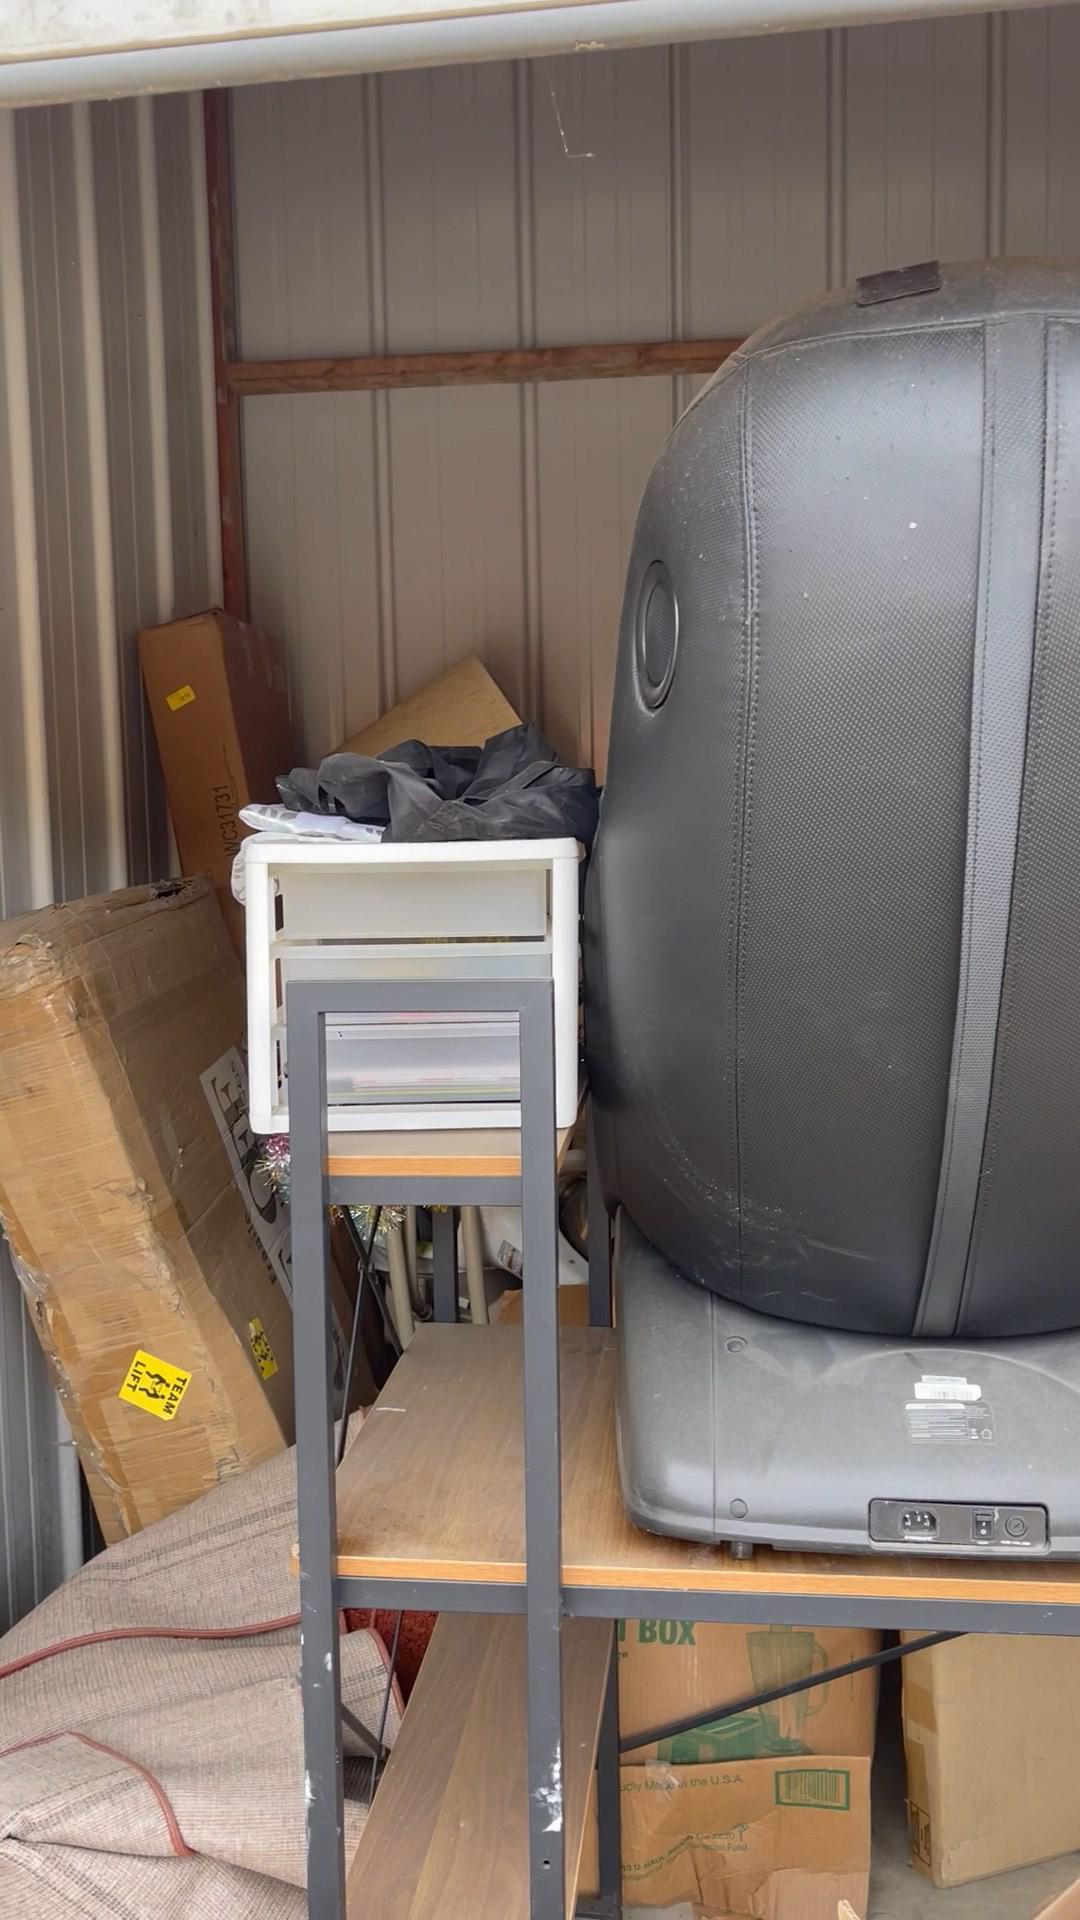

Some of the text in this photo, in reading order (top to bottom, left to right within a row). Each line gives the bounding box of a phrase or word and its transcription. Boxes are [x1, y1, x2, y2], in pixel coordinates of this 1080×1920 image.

[212, 785, 240, 857] WC31731
[126, 1359, 147, 1393] LIFT
[162, 1374, 188, 1416] TEAM
[638, 1618, 697, 1646] BOX
[690, 1777, 708, 1788] the
